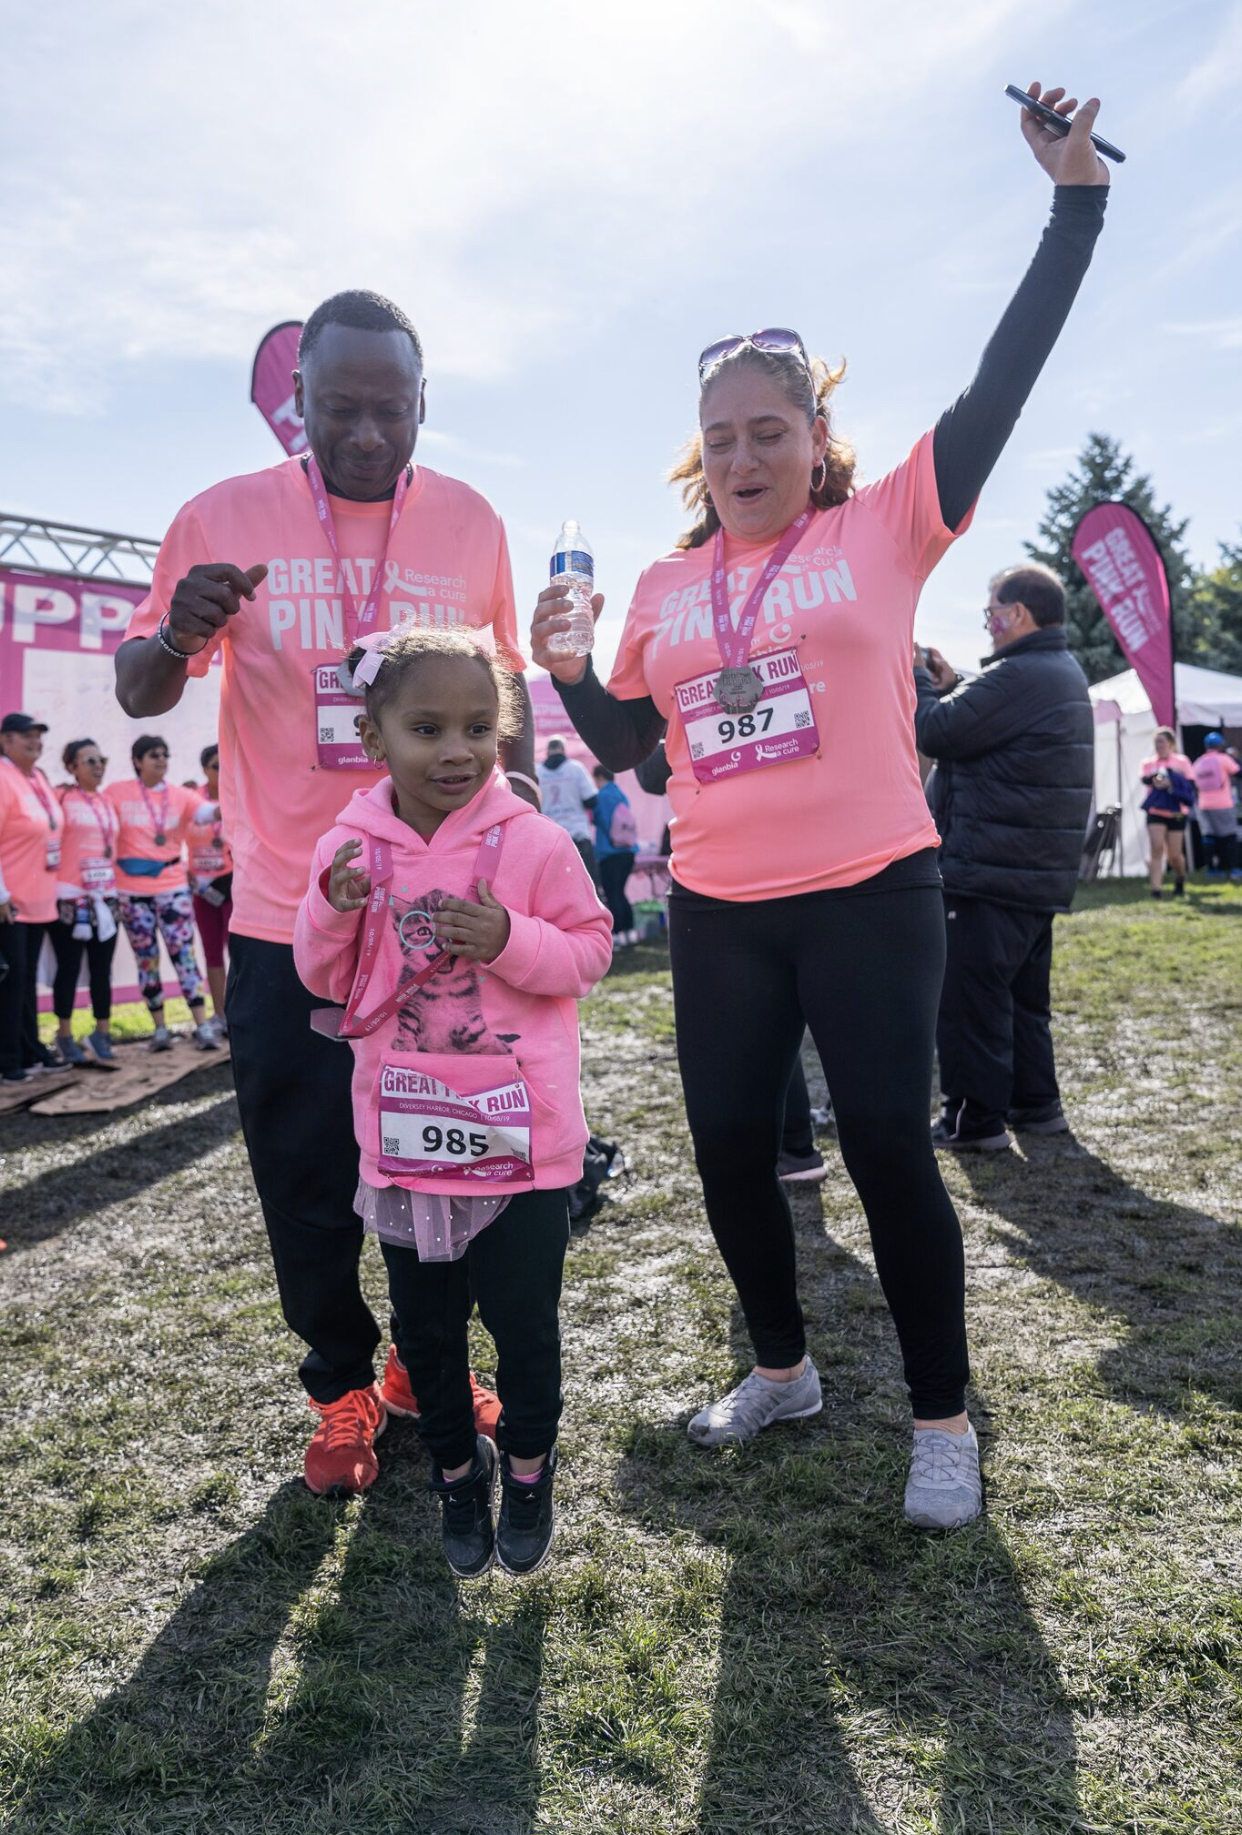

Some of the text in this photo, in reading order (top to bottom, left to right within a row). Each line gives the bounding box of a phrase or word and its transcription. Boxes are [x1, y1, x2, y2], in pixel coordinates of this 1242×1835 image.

[1104, 526, 1146, 588] GREAT
[267, 557, 376, 596] GREAT
[404, 568, 467, 590] Research
[427, 586, 467, 603] a cure
[762, 559, 858, 625] RUN
[1081, 539, 1149, 653] PINK RUN
[0, 580, 137, 650] PP
[766, 654, 799, 680] RUN
[718, 707, 774, 744] 987
[764, 738, 799, 753] Research
[776, 745, 800, 758] a cure
[338, 756, 369, 765] glanbia
[711, 761, 739, 777] glanbia
[399, 1102, 426, 1111] DIVERSEY
[451, 1107, 478, 1120] CHICAGO
[487, 1088, 526, 1113] RUN
[422, 1125, 490, 1157] 985
[494, 1168, 513, 1177] cure
